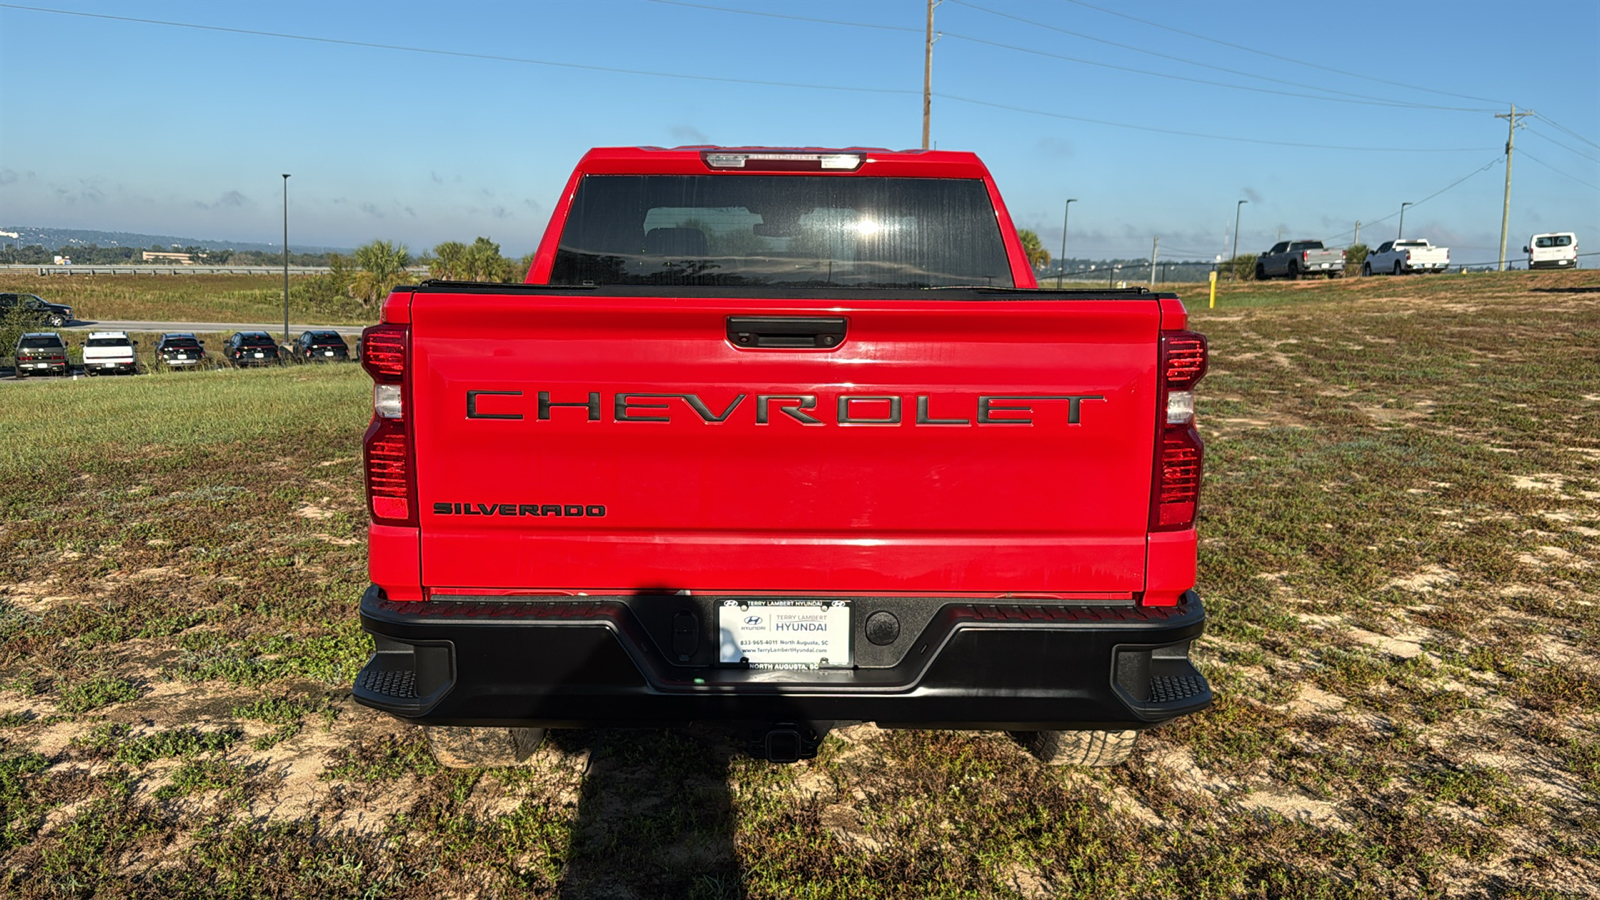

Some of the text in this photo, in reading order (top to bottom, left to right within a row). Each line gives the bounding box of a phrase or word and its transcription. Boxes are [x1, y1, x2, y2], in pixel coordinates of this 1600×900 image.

[466, 390, 1106, 425] CHEVROLET
[433, 502, 607, 517] SILVERADO
[776, 623, 828, 632] HYUNDAI
[774, 663, 808, 671] AUGUSTA,
